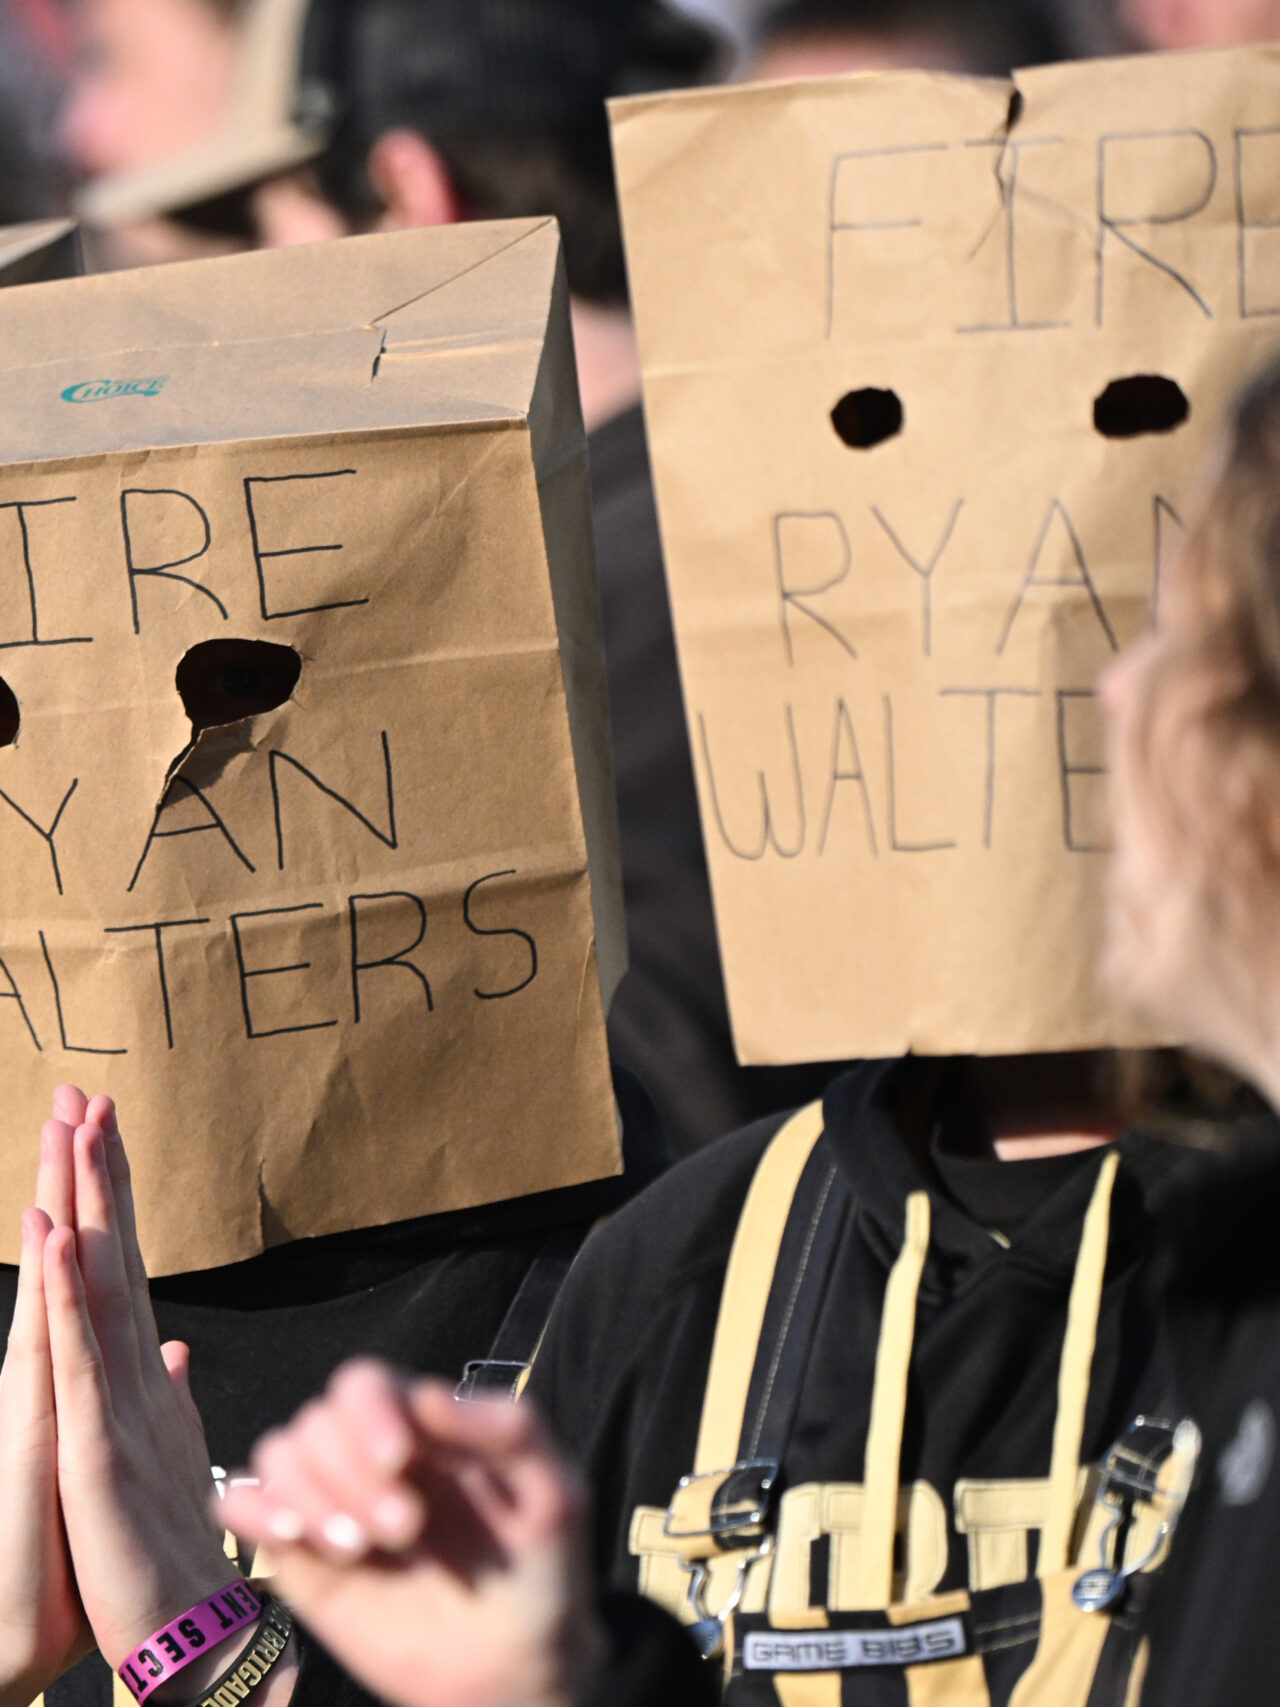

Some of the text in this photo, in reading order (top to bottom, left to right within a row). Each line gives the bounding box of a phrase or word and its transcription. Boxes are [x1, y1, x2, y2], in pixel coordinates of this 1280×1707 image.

[826, 126, 1280, 339] FIRE
[209, 1581, 263, 1630] ENT
[752, 1630, 956, 1664] GAME BIBS
